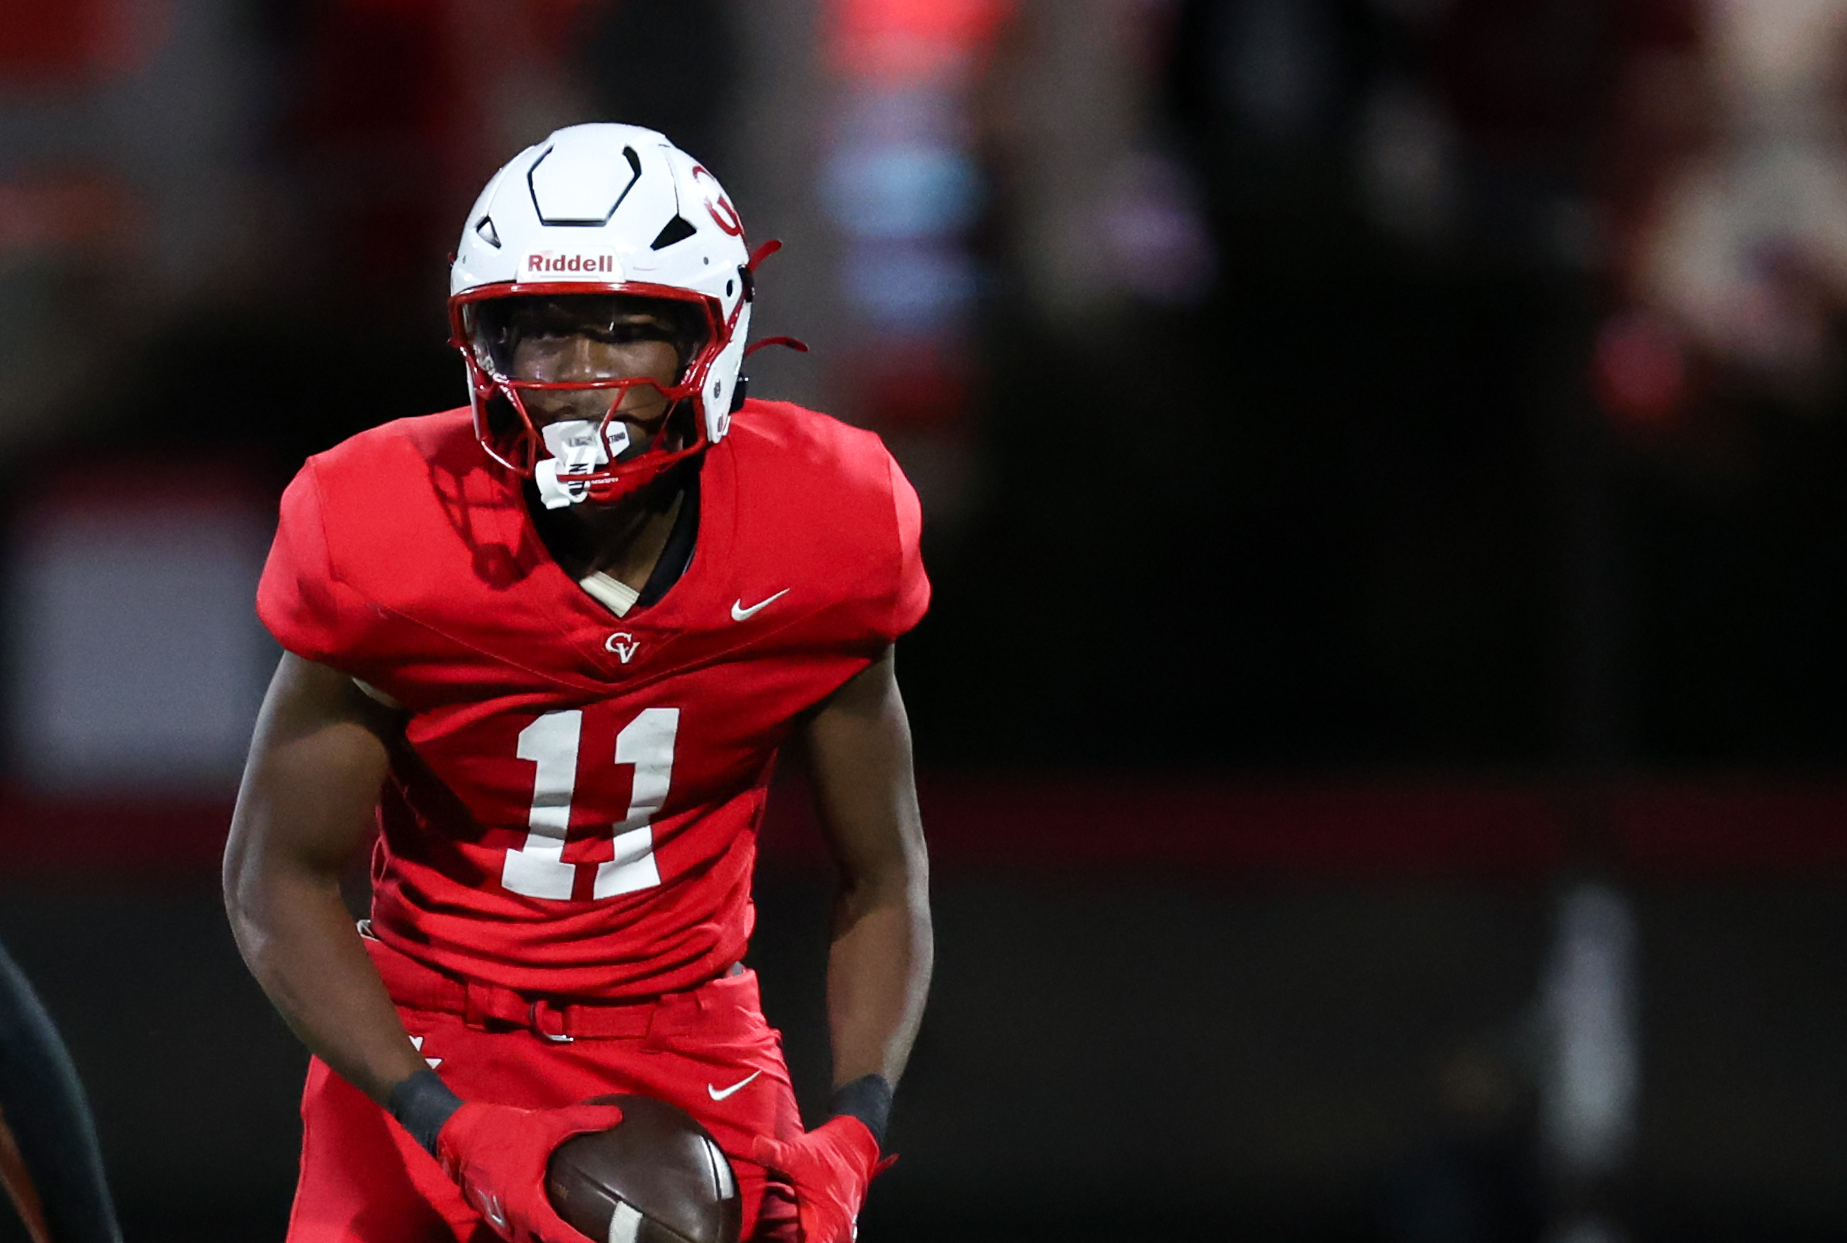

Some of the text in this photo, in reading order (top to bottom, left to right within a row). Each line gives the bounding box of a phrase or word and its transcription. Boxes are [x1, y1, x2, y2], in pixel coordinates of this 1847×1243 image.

[528, 254, 613, 272] Riddell
[605, 632, 641, 664] CV
[501, 708, 681, 900] 11
